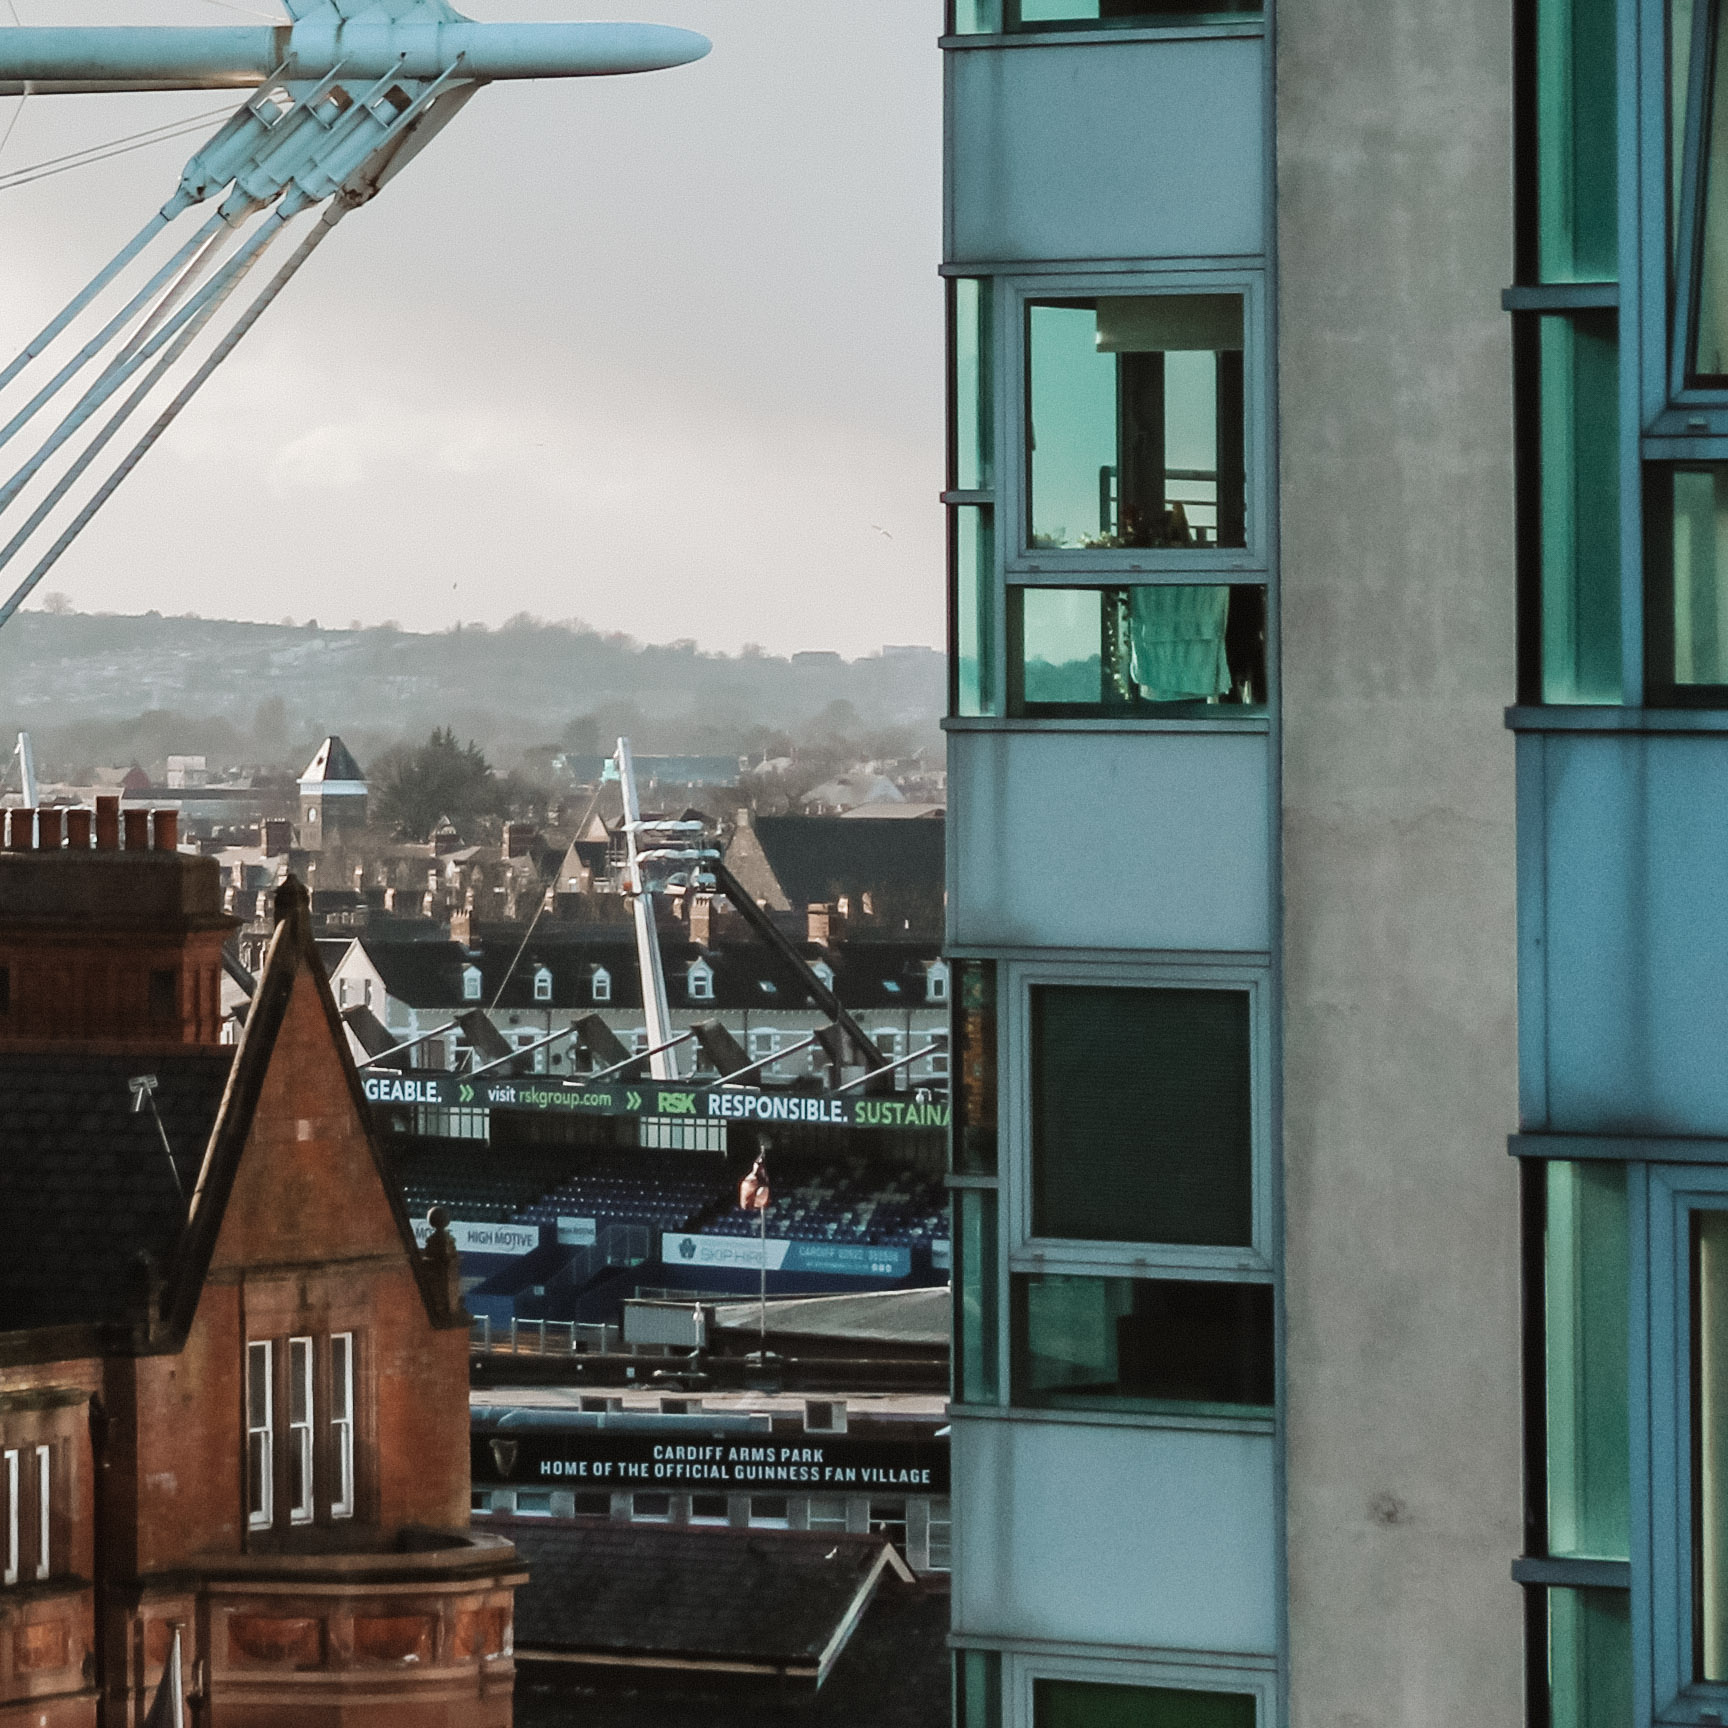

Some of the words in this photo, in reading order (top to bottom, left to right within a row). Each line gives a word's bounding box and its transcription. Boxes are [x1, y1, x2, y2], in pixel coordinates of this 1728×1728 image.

[361, 1078, 442, 1103] GEABLE.
[488, 1084, 516, 1103] visit
[519, 1087, 612, 1109] rskgroup.com
[657, 1091, 697, 1114] RSK
[707, 1092, 849, 1123] RESPONSIBLE.
[467, 1230, 494, 1245] HIGH
[494, 1230, 534, 1248] MOTIVE
[653, 1445, 724, 1461] CARDIFF
[728, 1446, 776, 1462] ARMS
[780, 1448, 824, 1463] PARK
[540, 1460, 587, 1476] HOME
[592, 1462, 613, 1476] OF
[617, 1462, 649, 1477] THE
[654, 1463, 730, 1479] OFFICIAL
[734, 1464, 820, 1481] GUINNESS
[825, 1466, 856, 1481] FAN
[861, 1467, 930, 1484] VILLAGE
